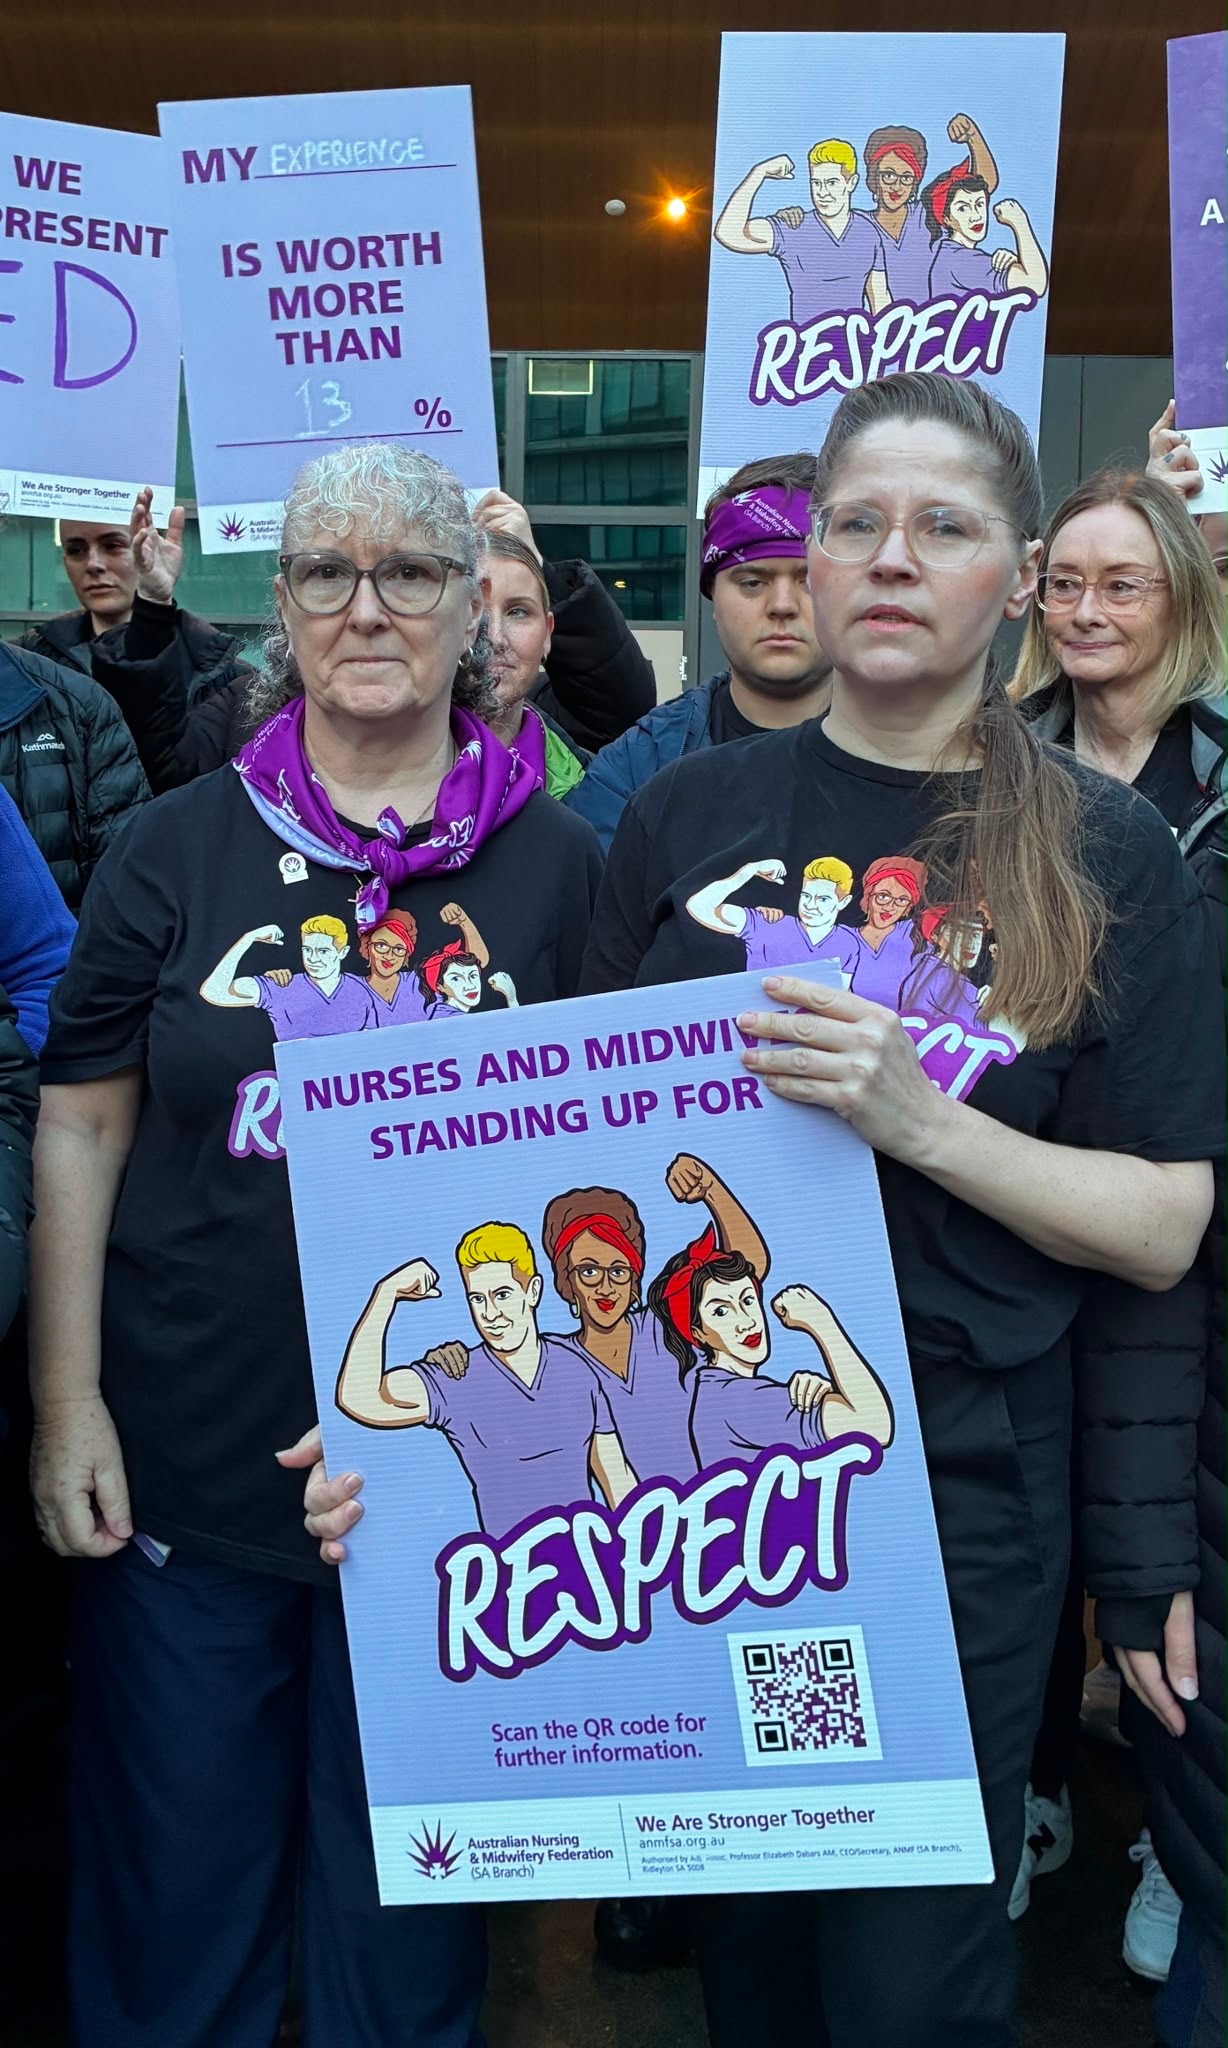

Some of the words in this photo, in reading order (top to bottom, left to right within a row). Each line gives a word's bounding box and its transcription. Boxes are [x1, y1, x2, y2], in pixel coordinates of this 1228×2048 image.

[13, 155, 82, 195] WE
[182, 147, 257, 184] MY
[270, 137, 425, 177] EXPERIENCE
[0, 206, 168, 258] RESENT
[221, 242, 261, 278] IS
[276, 231, 442, 274] WORTH
[268, 280, 404, 321] MORE
[276, 325, 402, 365] THAN
[755, 294, 1032, 400] RESPECT
[295, 378, 352, 438] 13
[413, 397, 452, 429] %
[21, 480, 36, 490] We
[38, 483, 53, 492] Are
[54, 484, 91, 497] Stronger
[93, 488, 131, 499] Together
[754, 498, 783, 521] Australian
[754, 505, 783, 532] Midwifery
[303, 1058, 461, 1111] NURSES
[476, 1044, 570, 1088] AND
[370, 1099, 588, 1159] STANDING
[603, 1089, 658, 1128] UP
[675, 1075, 763, 1119] FOR
[445, 1443, 873, 1670] RESPECT
[492, 1723, 538, 1743] Scan
[543, 1720, 578, 1739] the
[583, 1718, 615, 1740] QR
[620, 1714, 670, 1735] code
[675, 1712, 707, 1733] for
[494, 1746, 567, 1768] further
[572, 1740, 703, 1764] information.
[635, 1816, 666, 1832] We
[672, 1815, 703, 1831] Are
[708, 1813, 787, 1831] Stronger
[791, 1806, 875, 1829] Together
[468, 1835, 529, 1850] Australian
[532, 1833, 579, 1848] Nursing
[470, 1853, 479, 1864] &
[482, 1850, 544, 1865] Midwifery
[548, 1847, 614, 1861] Federation
[639, 1836, 725, 1850] anmfsa.org.au
[680, 1855, 689, 1863] by
[729, 1852, 761, 1860] Professor
[763, 1850, 795, 1859] Elizabeth
[471, 1866, 491, 1881] (SA
[493, 1865, 535, 1880] Branch)
